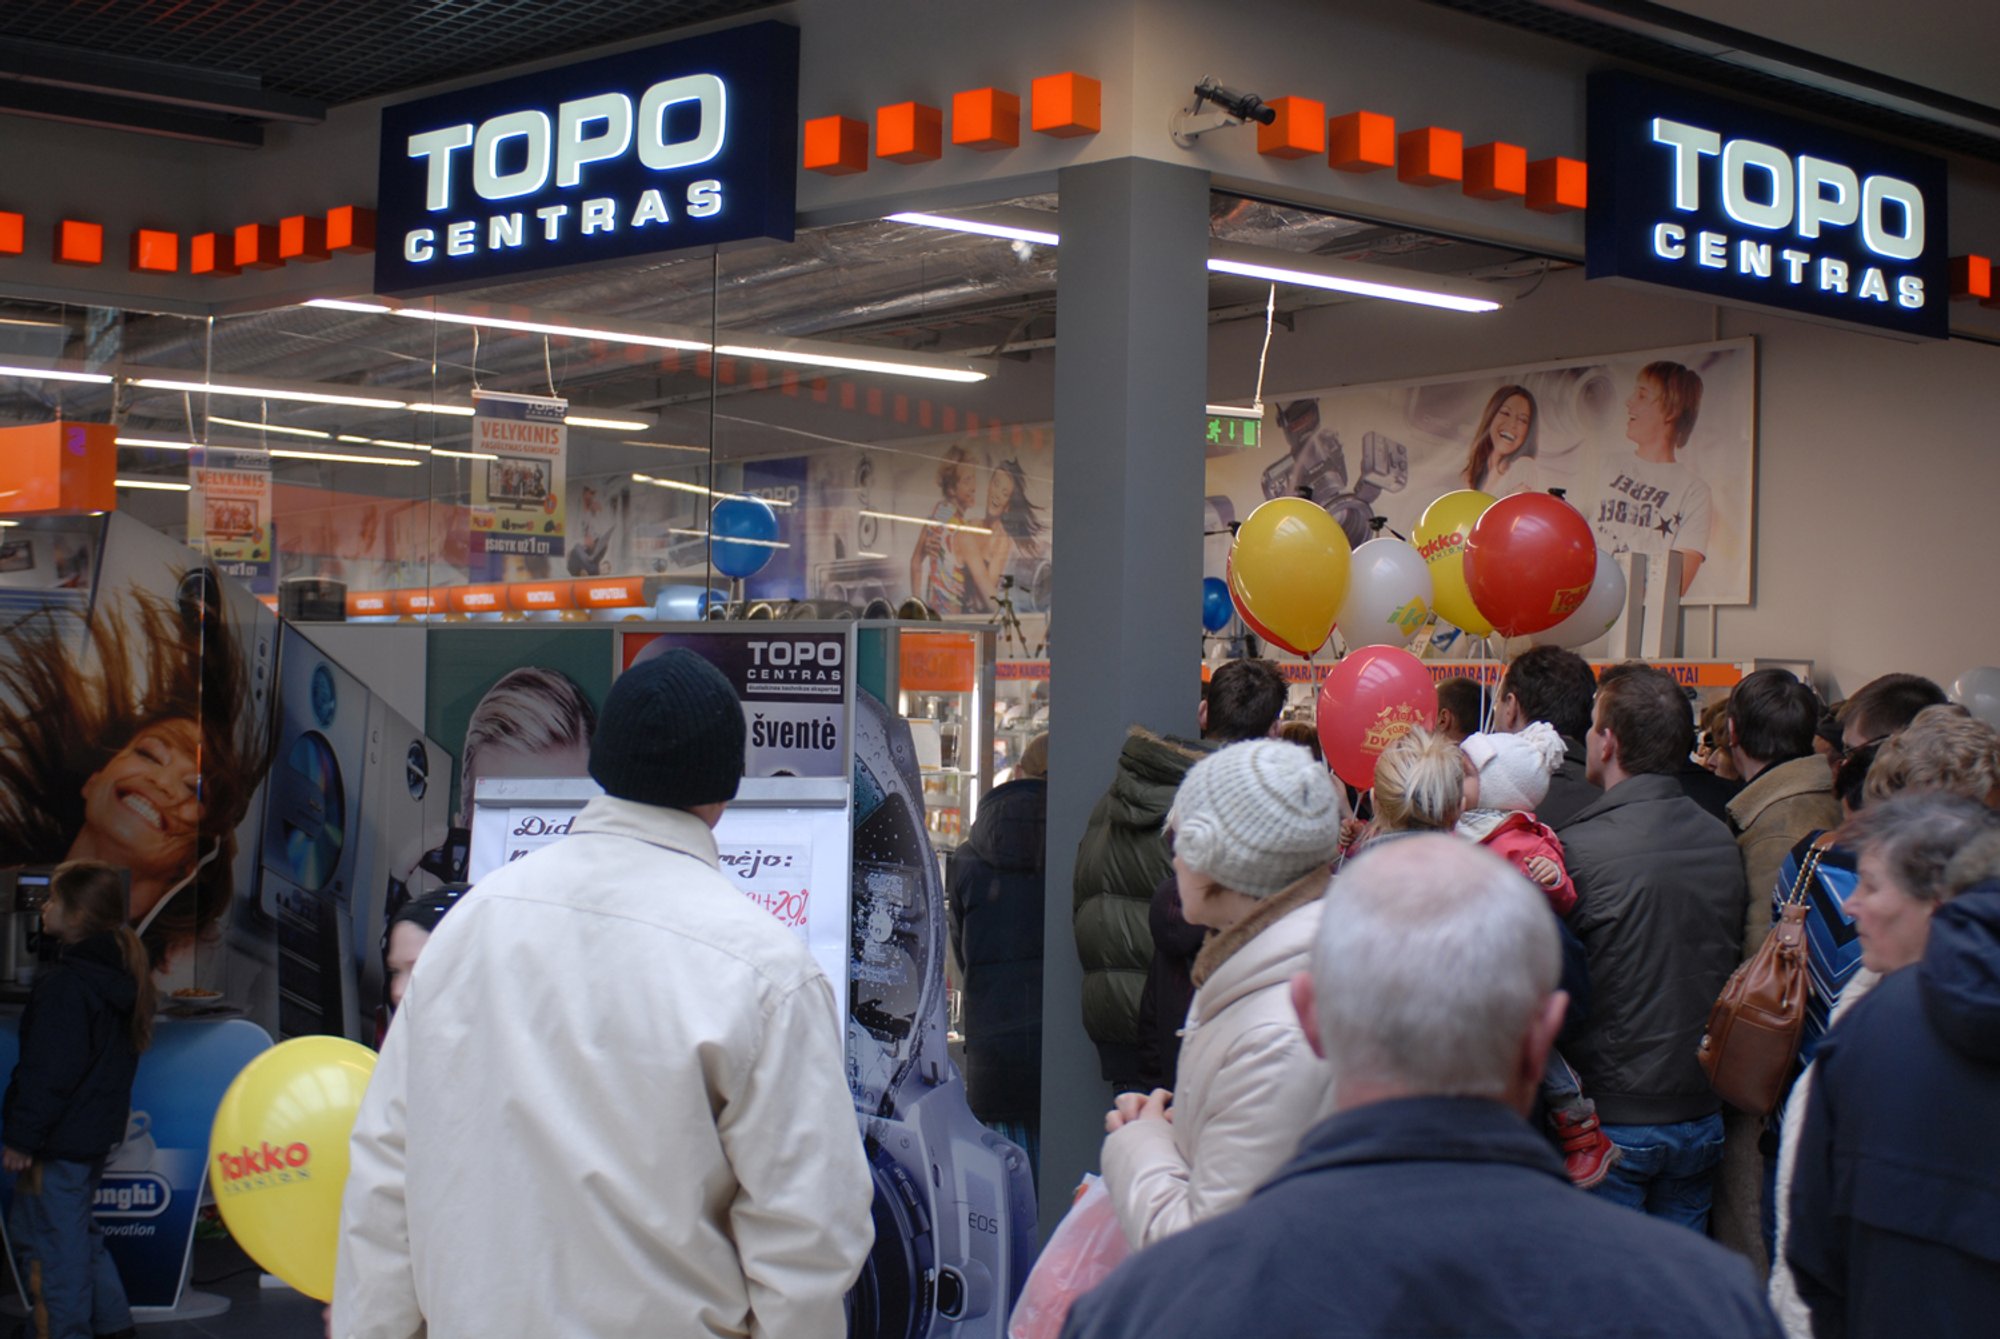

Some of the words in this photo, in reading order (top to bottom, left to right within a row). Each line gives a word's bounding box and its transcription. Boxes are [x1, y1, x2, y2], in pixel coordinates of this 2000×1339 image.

[407, 73, 727, 211] TOPO
[1652, 116, 1925, 260] TOPO
[403, 179, 722, 263] CENTRAS
[1653, 222, 1925, 309] CENTRAS
[481, 421, 560, 446] VELYKINIS
[747, 641, 842, 667] TOPO
[747, 668, 841, 681] CENTRAS
[752, 712, 837, 751] šventė
[513, 815, 576, 836] Did
[217, 1141, 309, 1181] Takko
[968, 1212, 998, 1235] EOS
